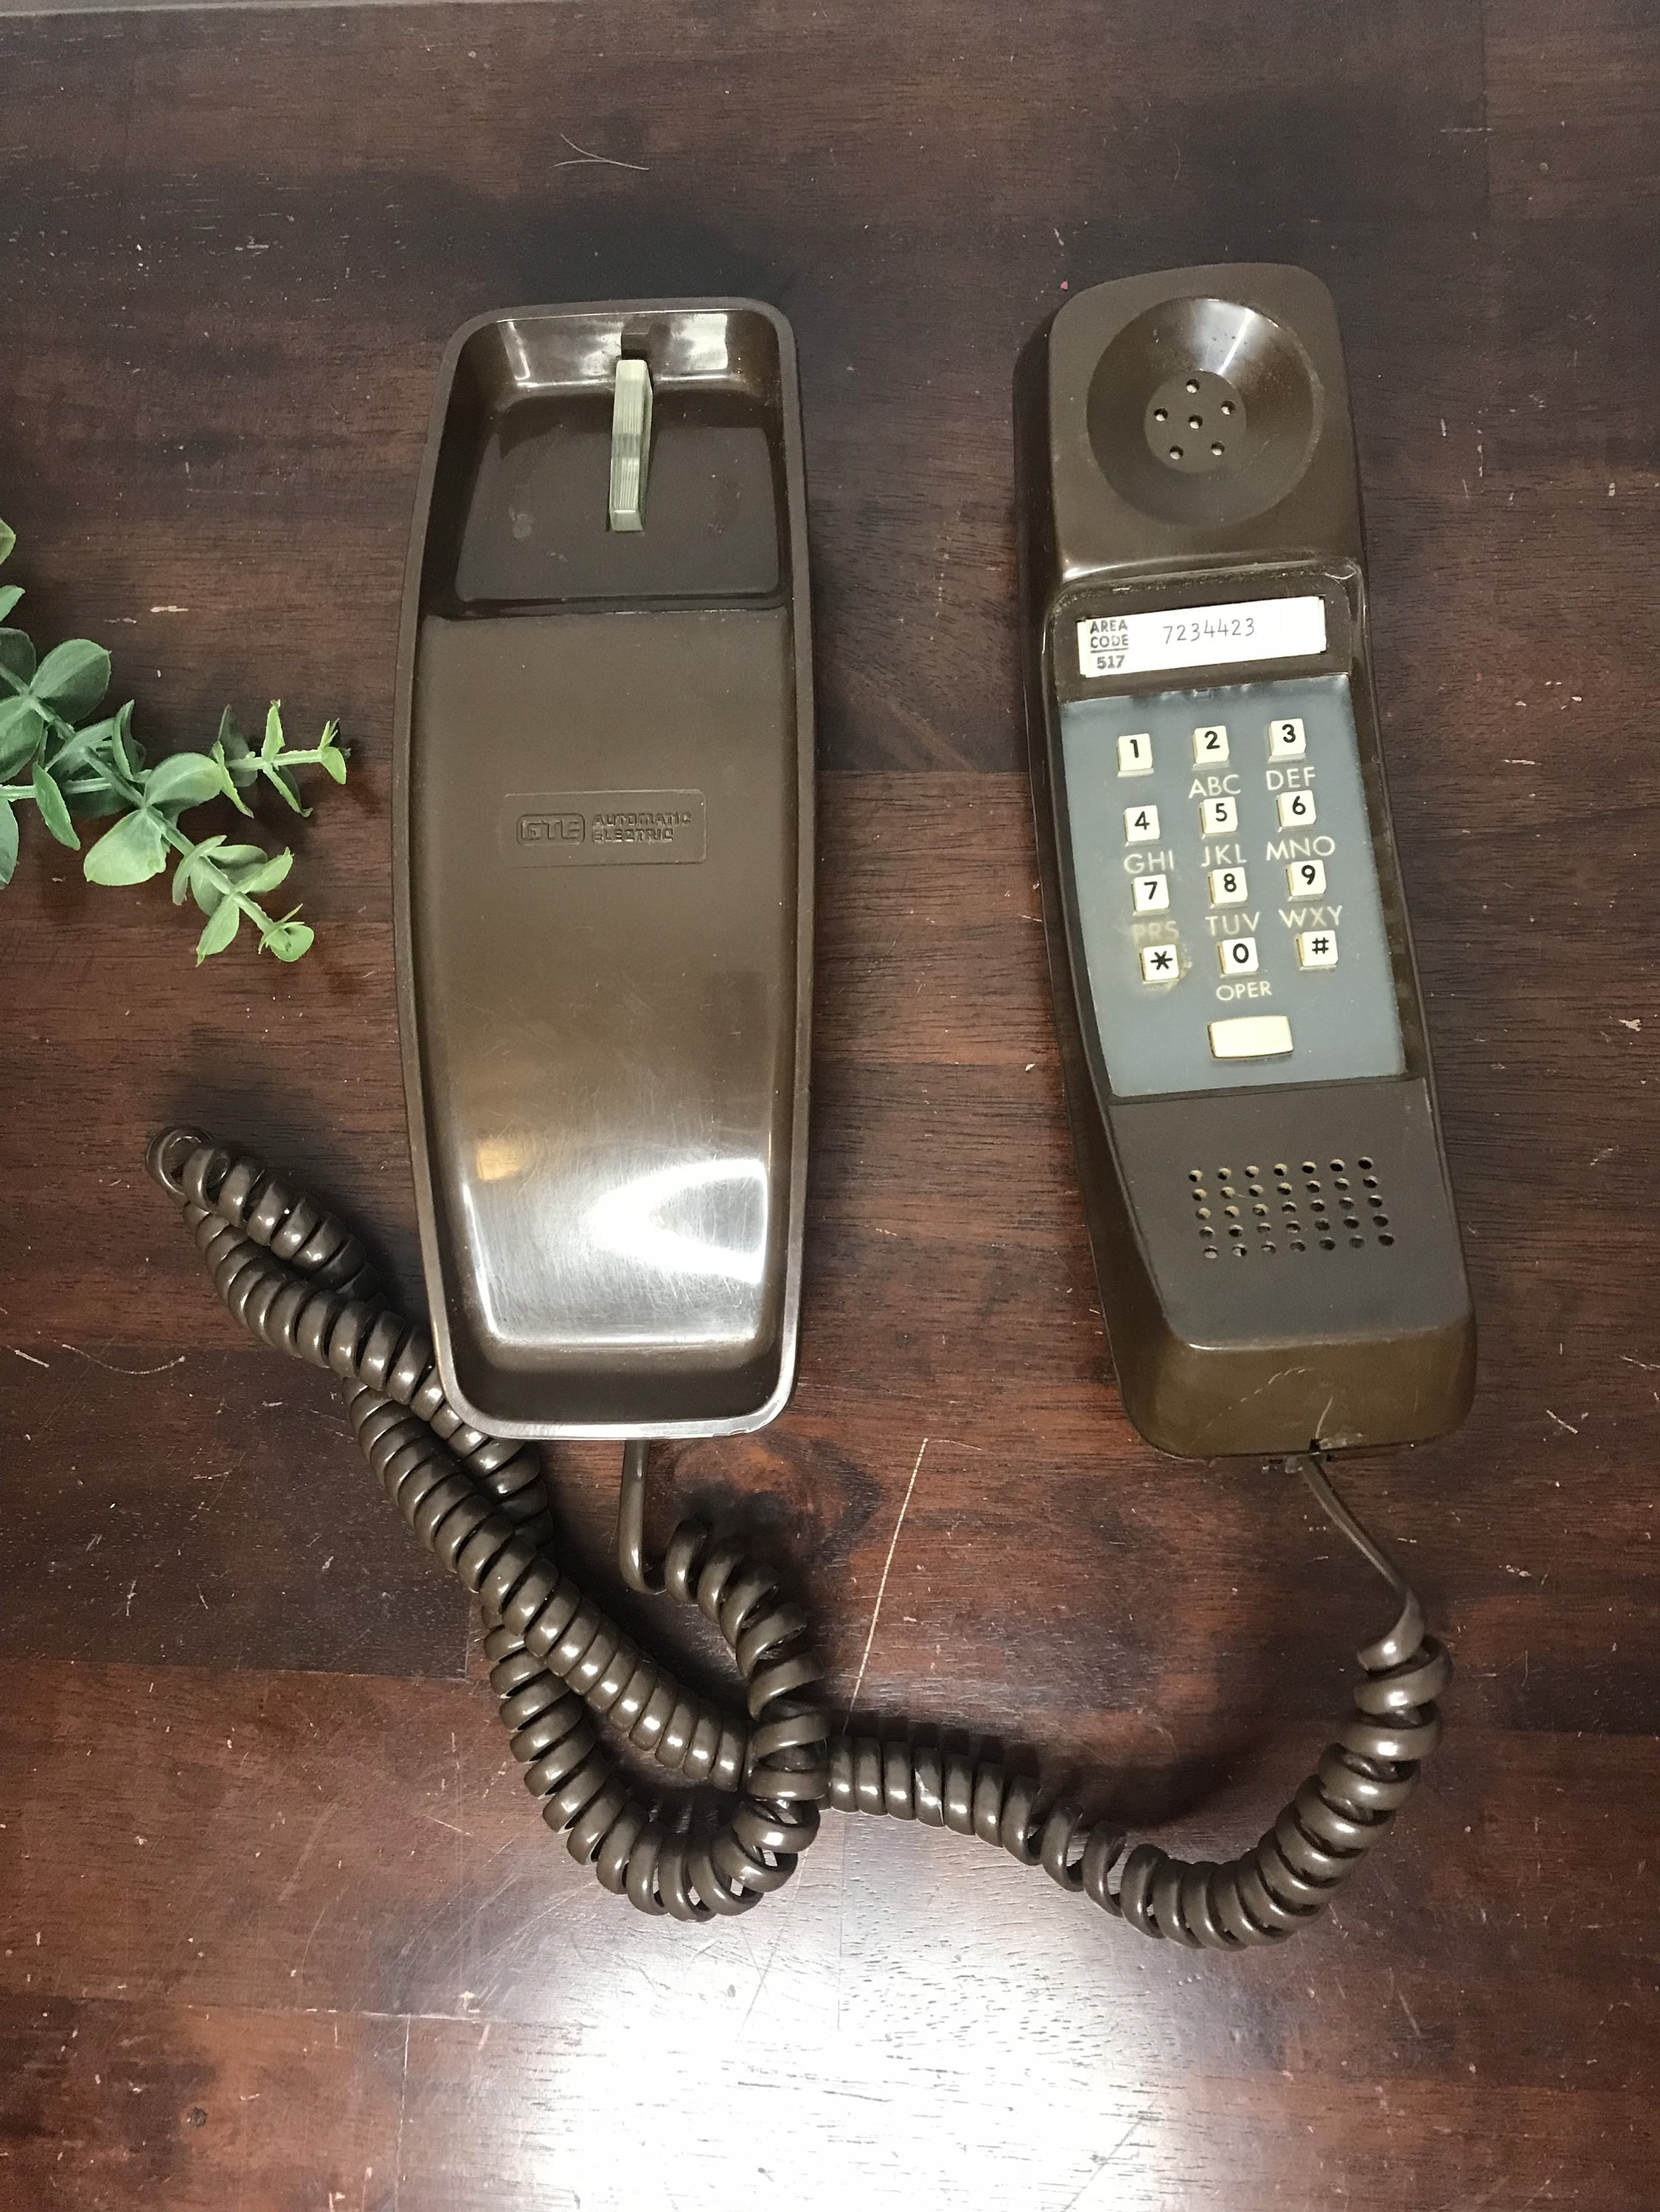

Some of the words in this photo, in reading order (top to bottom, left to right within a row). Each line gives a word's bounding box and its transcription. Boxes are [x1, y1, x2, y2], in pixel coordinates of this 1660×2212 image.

[1090, 619, 1128, 633] AREA
[1163, 617, 1255, 644] 7234423
[1091, 634, 1129, 648] CODE
[1097, 655, 1125, 669] 517
[1204, 731, 1220, 750] 2
[1282, 723, 1296, 743] 3
[1130, 739, 1139, 758] 1
[1188, 774, 1241, 799] ABC
[1265, 766, 1316, 791] DEF
[1215, 802, 1228, 822] 5
[1292, 796, 1307, 815] 6
[591, 813, 692, 827] AUTOMATIC
[1134, 811, 1150, 830] 4
[591, 828, 674, 844] ELECTRIC
[1201, 844, 1247, 867] JKL
[1266, 835, 1336, 861] MNO
[1123, 850, 1175, 874] GHI
[1223, 873, 1237, 893] 8
[1301, 864, 1316, 885] 9
[1144, 881, 1158, 900] 7
[1205, 911, 1260, 936] TUV
[1278, 905, 1343, 929] WXY
[1131, 921, 1179, 943] PRS
[1216, 981, 1273, 1001] OPER
